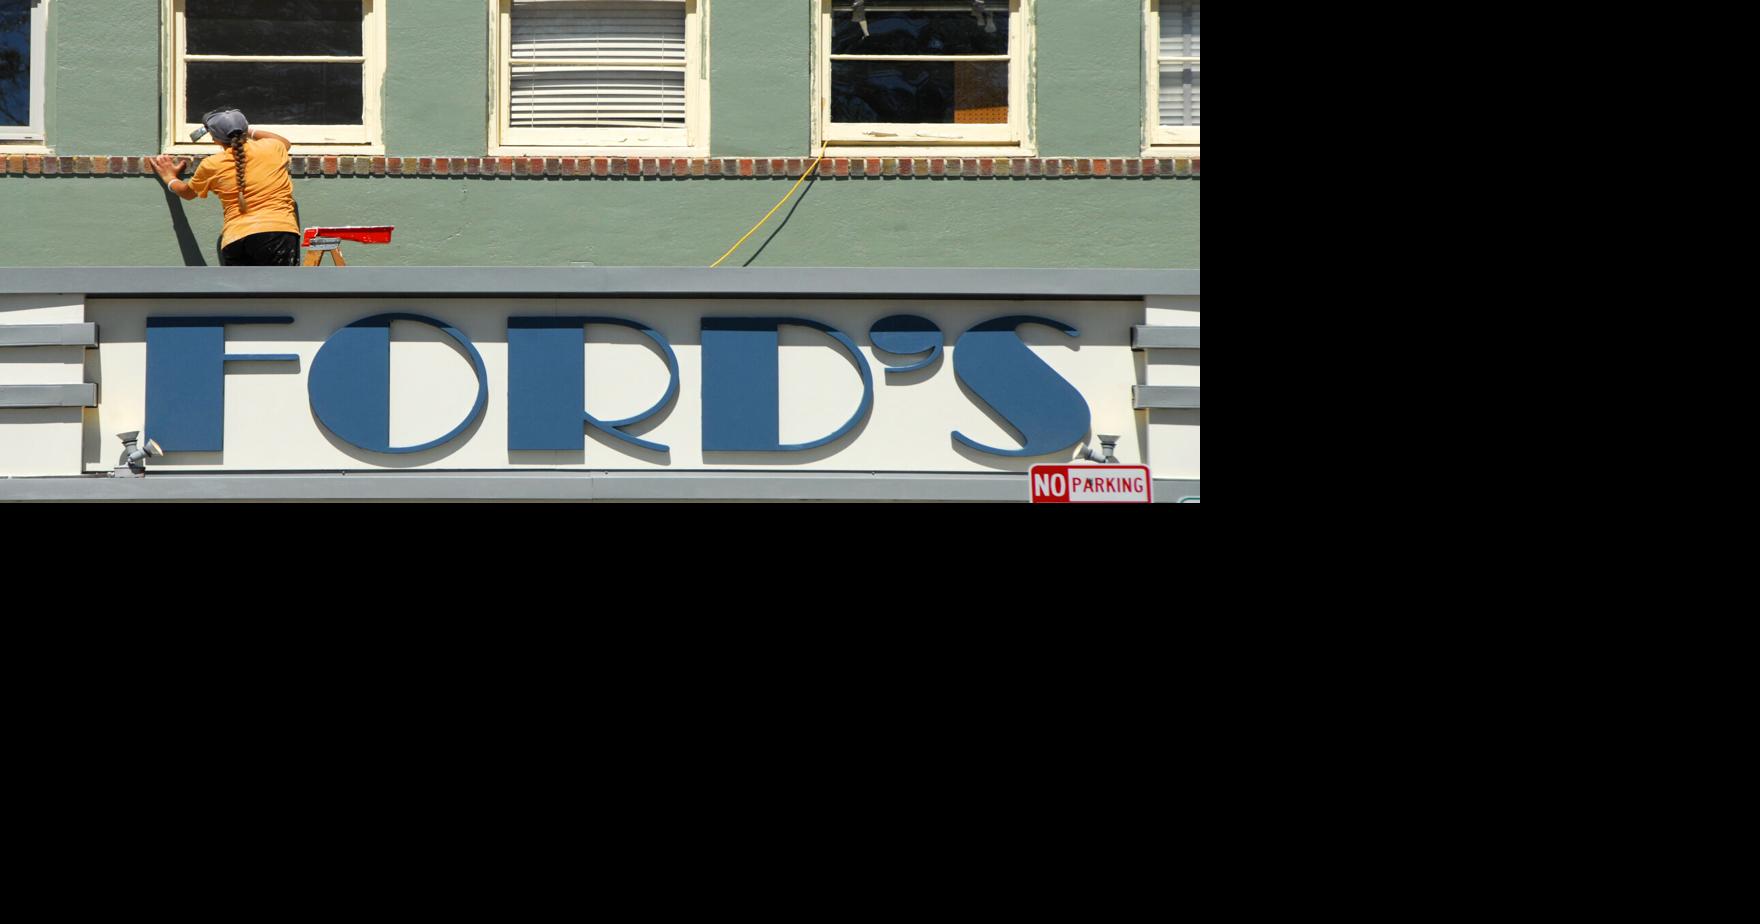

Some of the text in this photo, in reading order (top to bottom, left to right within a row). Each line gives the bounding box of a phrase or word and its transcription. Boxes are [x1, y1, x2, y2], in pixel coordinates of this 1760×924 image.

[146, 313, 1091, 456] FORD'S
[1034, 473, 1144, 497] NO PARKING
